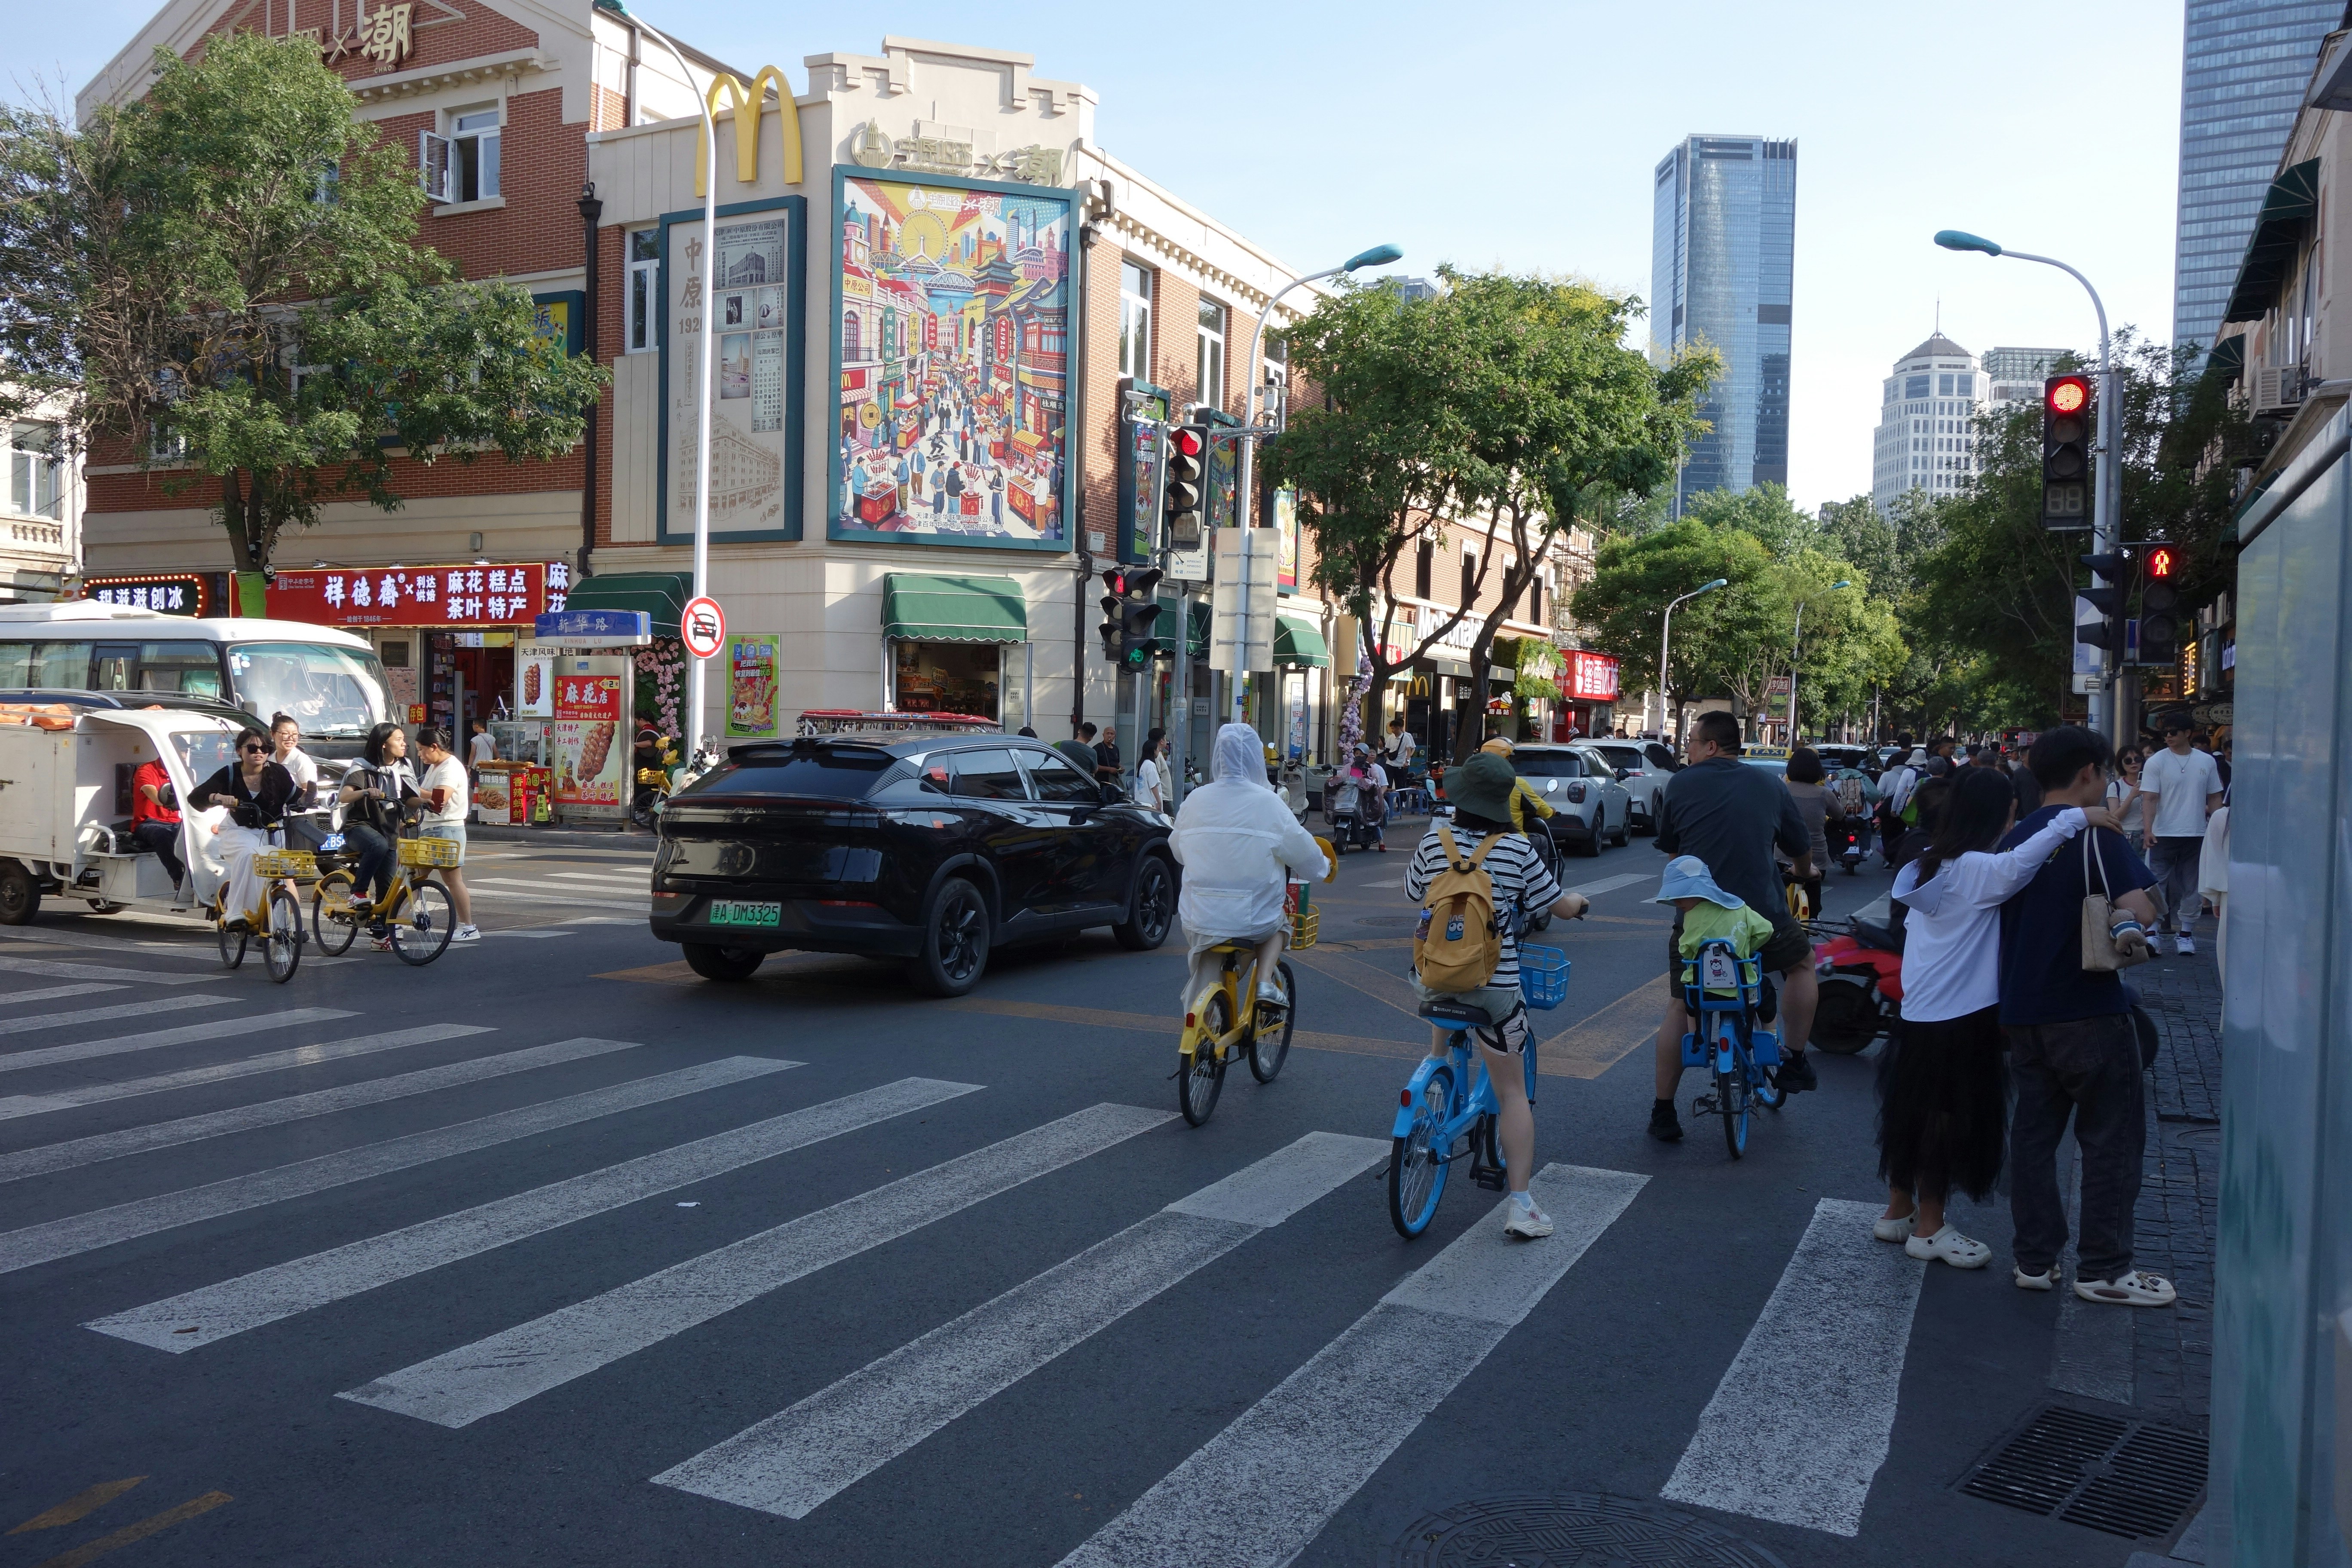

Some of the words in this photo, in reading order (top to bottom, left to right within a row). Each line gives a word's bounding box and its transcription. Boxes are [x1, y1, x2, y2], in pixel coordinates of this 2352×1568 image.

[360, 3, 411, 64] 潮
[374, 65, 392, 74] CHAO
[1013, 144, 1064, 186] 潮
[680, 237, 702, 309] 中原
[845, 278, 870, 294] 中原公司
[885, 313, 894, 358] 百货大楼
[992, 367, 1011, 379] 可口可乐
[1041, 398, 1064, 411] 桂顺斋
[416, 575, 436, 589] 利达
[447, 570, 482, 594] 麻花
[488, 569, 526, 593] 糕点
[547, 562, 569, 613] 麻花
[98, 586, 184, 609] 甜滋滋刨冰
[416, 589, 436, 602] 烘焙
[447, 597, 482, 620] 茶叶
[488, 596, 526, 619] 特产
[558, 616, 609, 633] 新华路
[521, 648, 556, 656] 天津风味
[740, 659, 768, 668] 把我的身体
[735, 668, 771, 678] 恢复到最佳状态
[1583, 658, 1619, 695] 蜜雪冰城
[565, 682, 607, 704] 麻花店
[410, 706, 423, 722] 存包
[557, 723, 579, 732] 天津特产
[557, 736, 579, 746] 手工制作
[478, 775, 508, 784] 香辣蚂蚱
[581, 781, 597, 790] 麻花
[600, 781, 615, 790] 糕点
[513, 777, 524, 819] 香辣蚂蚱
[581, 791, 597, 801] 茶叶
[600, 791, 615, 801] 特产
[1528, 1210, 1540, 1222] HOKA
